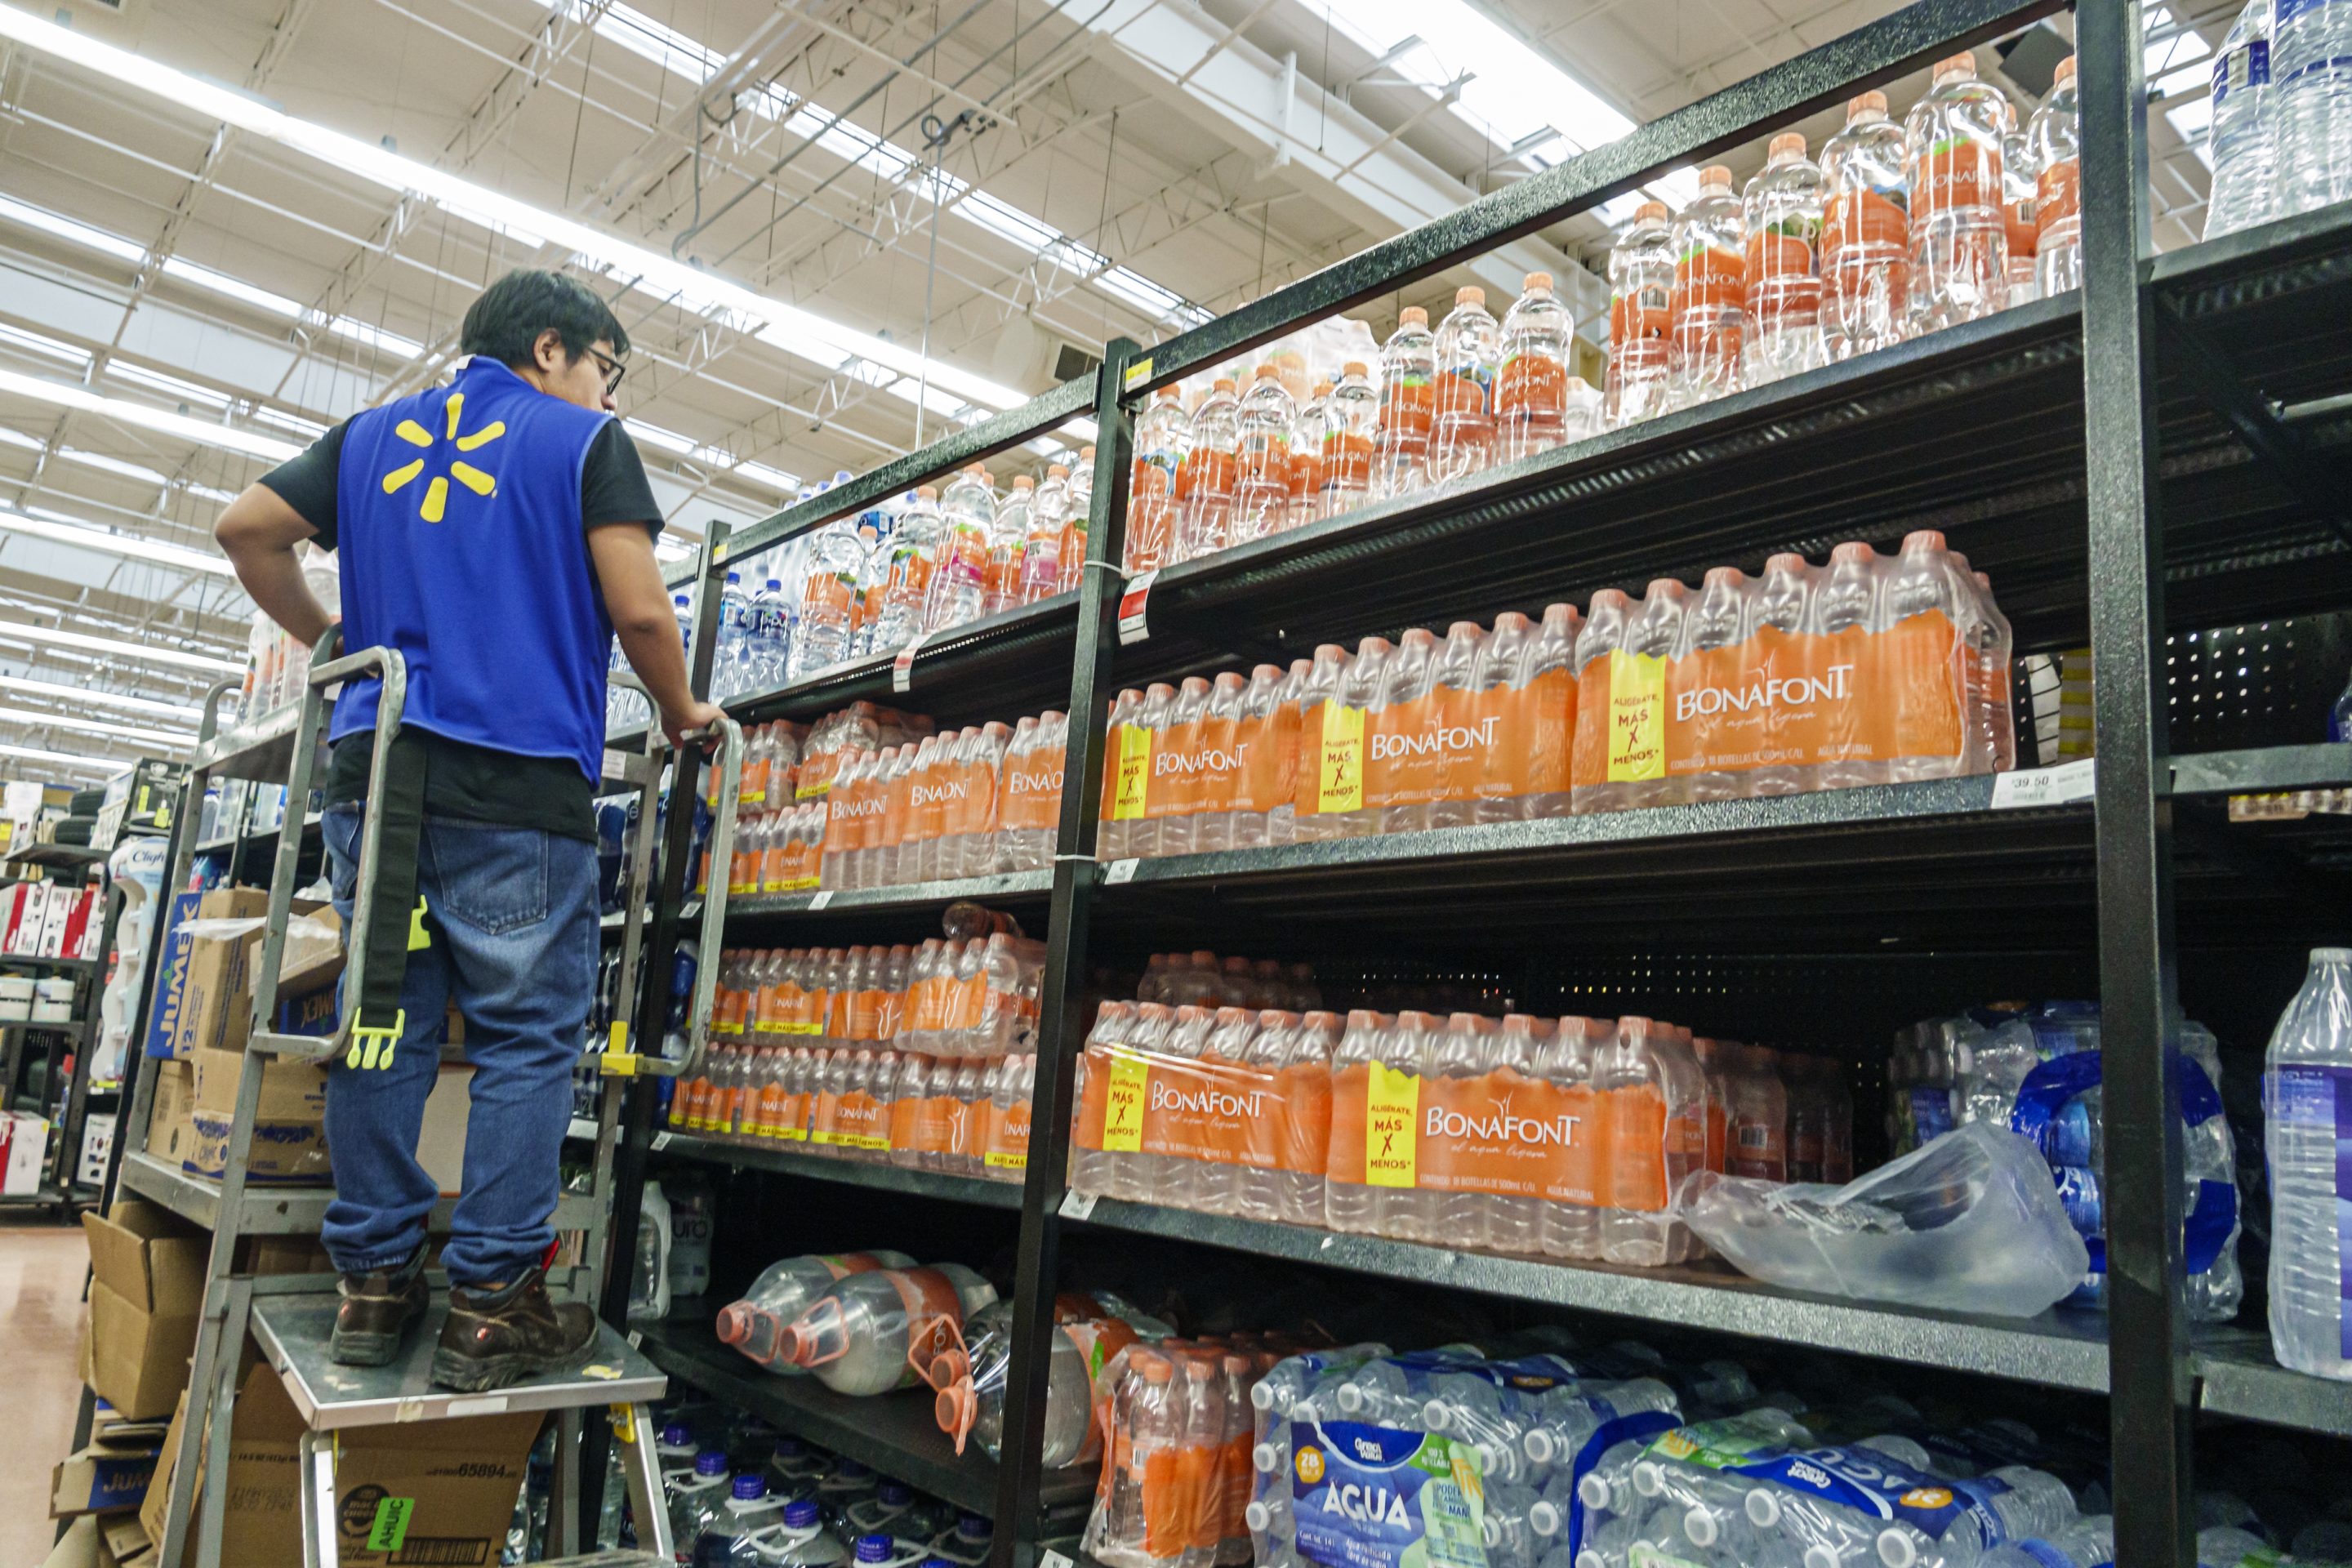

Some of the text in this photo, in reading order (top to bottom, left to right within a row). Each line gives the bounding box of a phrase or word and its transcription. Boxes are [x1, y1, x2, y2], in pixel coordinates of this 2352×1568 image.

[1676, 664, 1854, 722] BONAFONT
[1371, 715, 1501, 761] BONAFONT
[1618, 709, 1648, 727] MÁS
[1155, 743, 1249, 777] BONAFONT
[160, 901, 200, 1047] JUMEX
[1112, 1090, 1134, 1104] MÁS
[1151, 1079, 1265, 1118] BONAFONT
[1374, 1116, 1403, 1133] MÁS
[1427, 1106, 1581, 1147] BONAFONT
[1322, 1481, 1411, 1531] AGUA
